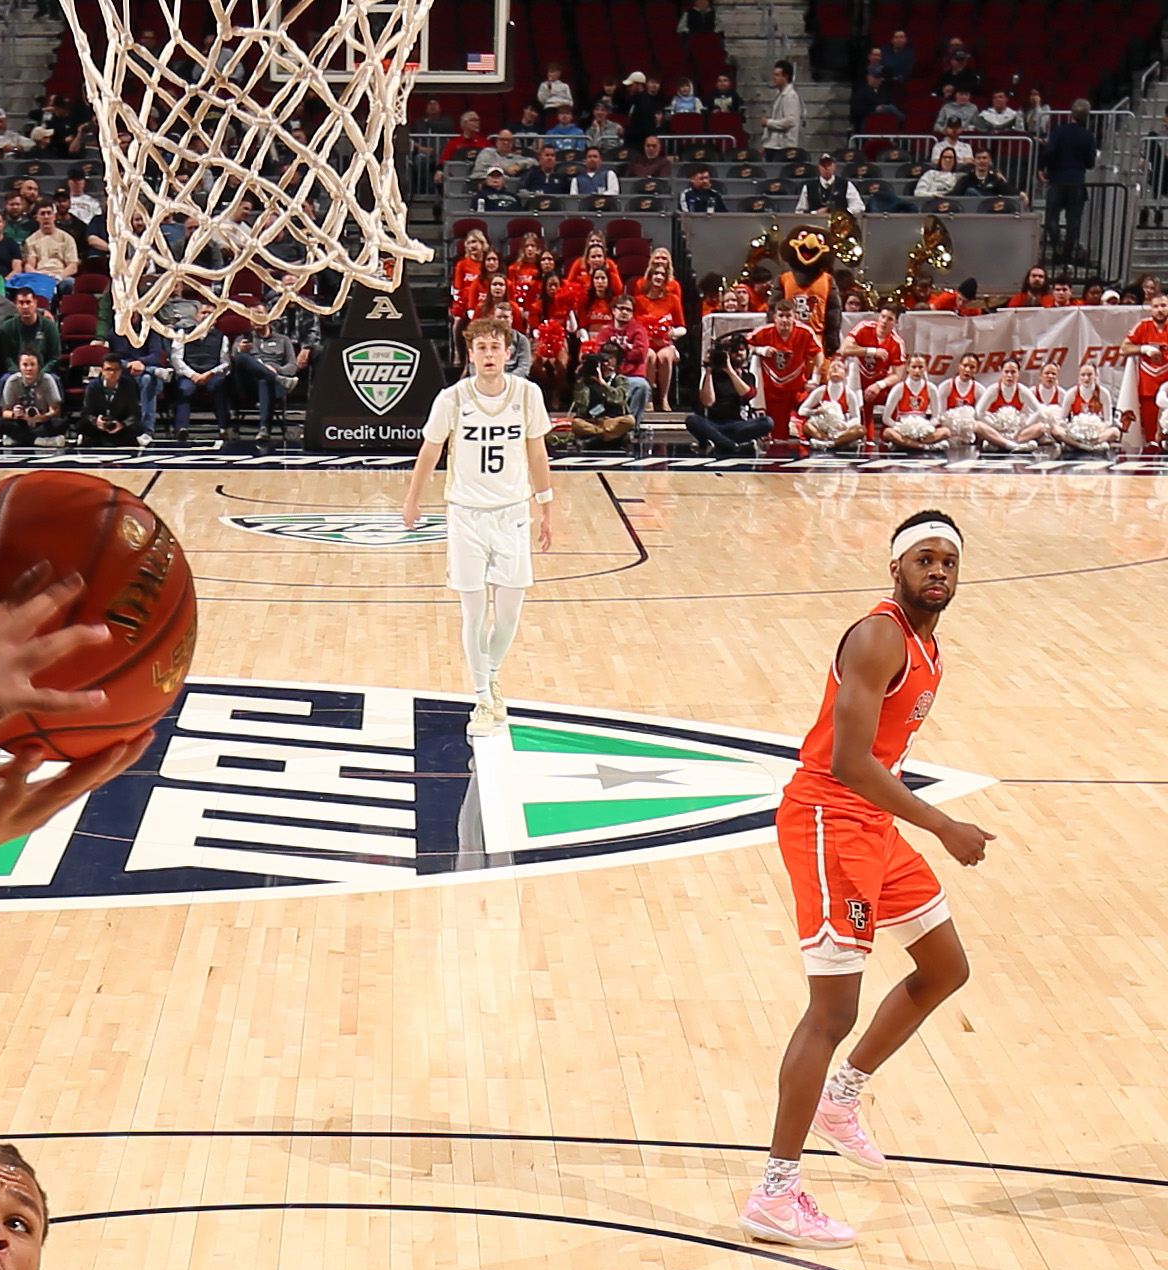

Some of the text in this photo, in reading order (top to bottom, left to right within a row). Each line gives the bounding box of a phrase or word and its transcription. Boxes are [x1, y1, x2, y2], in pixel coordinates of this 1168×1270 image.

[365, 296, 403, 320] A
[1079, 345, 1128, 370] FA
[352, 364, 412, 383] MAC
[325, 424, 375, 441] Credit
[462, 425, 521, 441] ZIPS
[480, 445, 504, 474] 15
[123, 689, 416, 884] MAC
